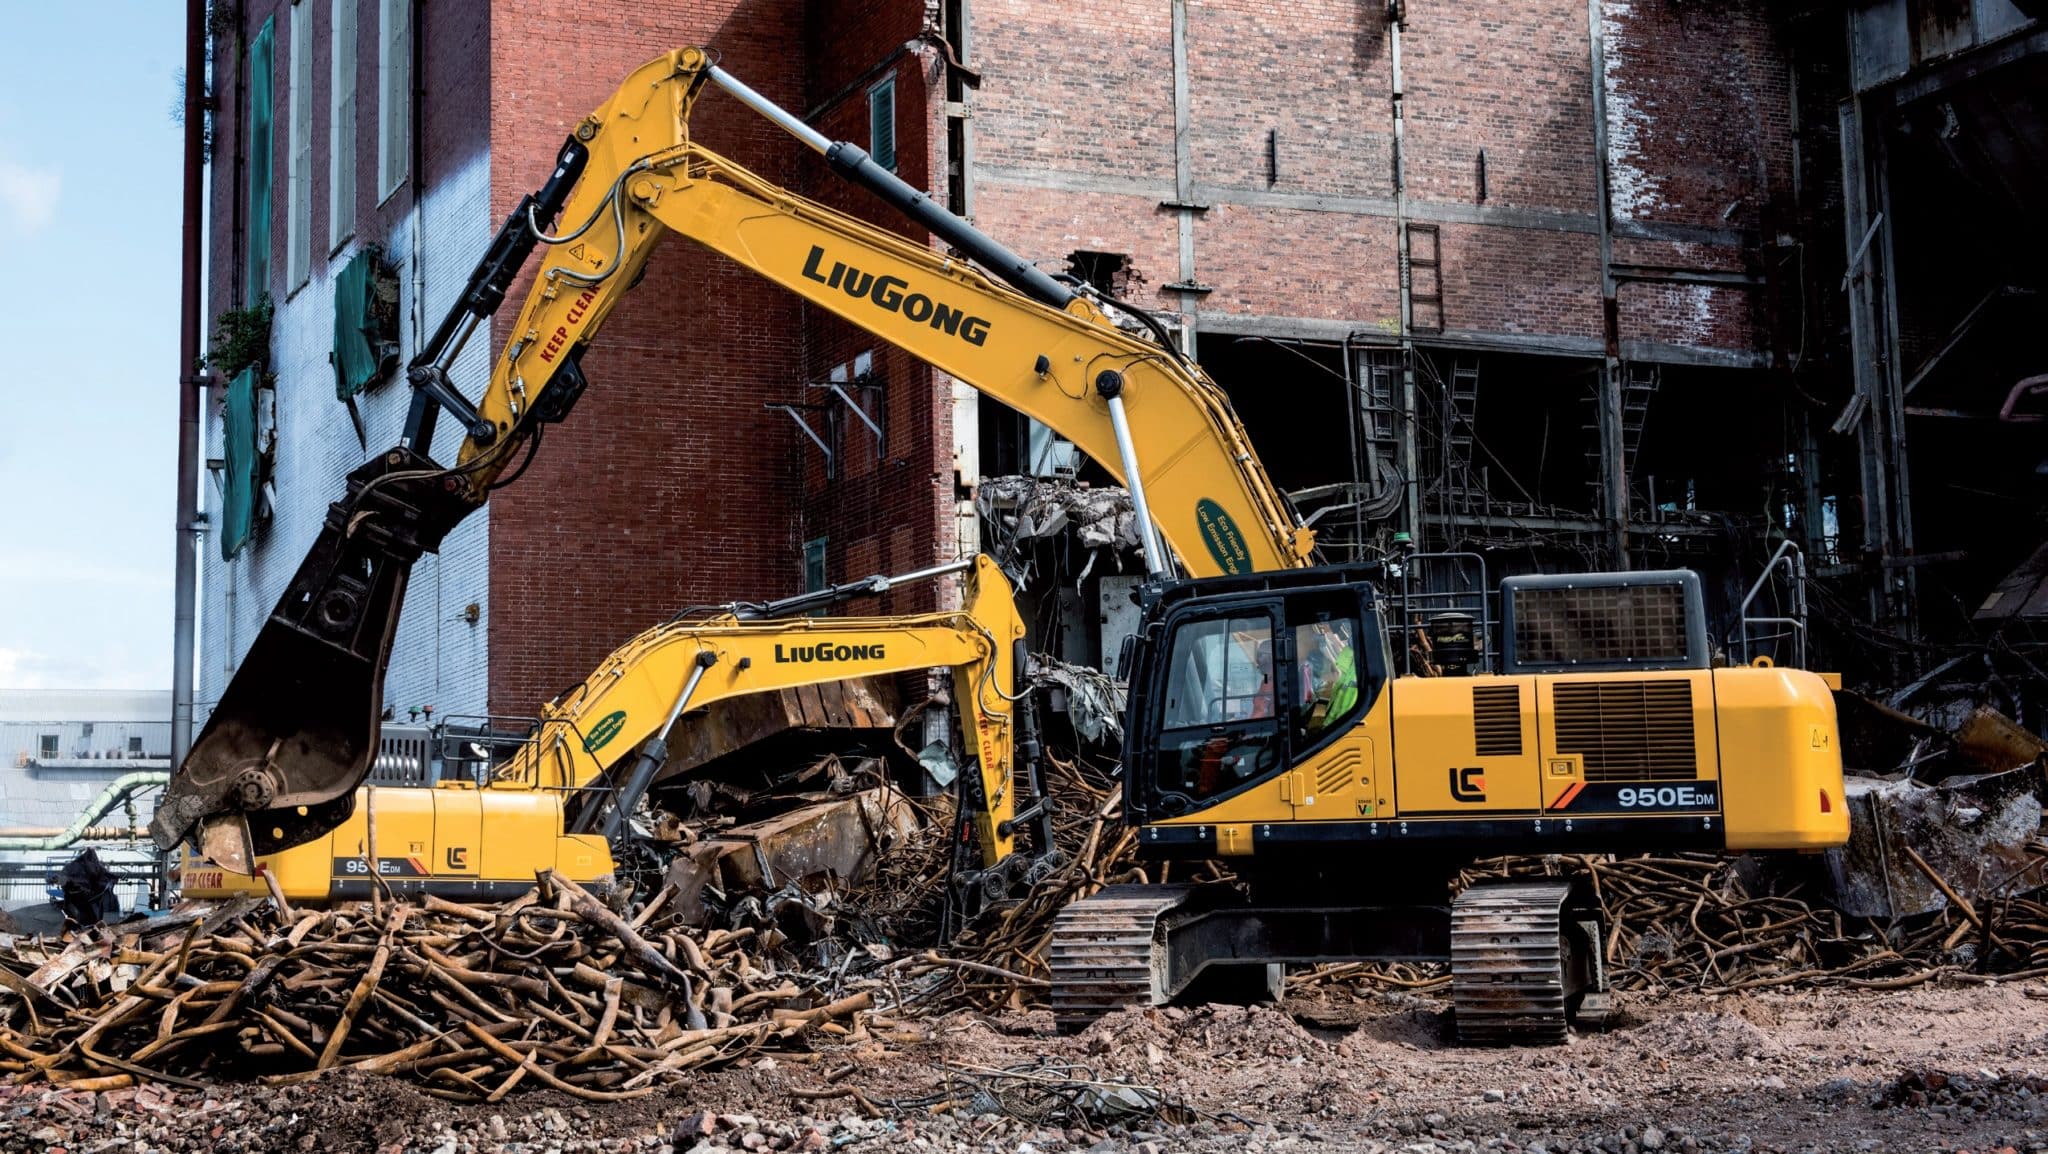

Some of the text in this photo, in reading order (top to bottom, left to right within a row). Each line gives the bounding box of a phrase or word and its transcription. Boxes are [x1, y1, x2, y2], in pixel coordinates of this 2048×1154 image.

[540, 284, 600, 363] KEEP CLEAR
[1198, 505, 1210, 523] Low
[1207, 522, 1229, 557] Emission
[1217, 515, 1246, 560] Eco Friendly
[978, 712, 994, 769] KEEP CLEAR
[198, 872, 223, 889] CLEAR
